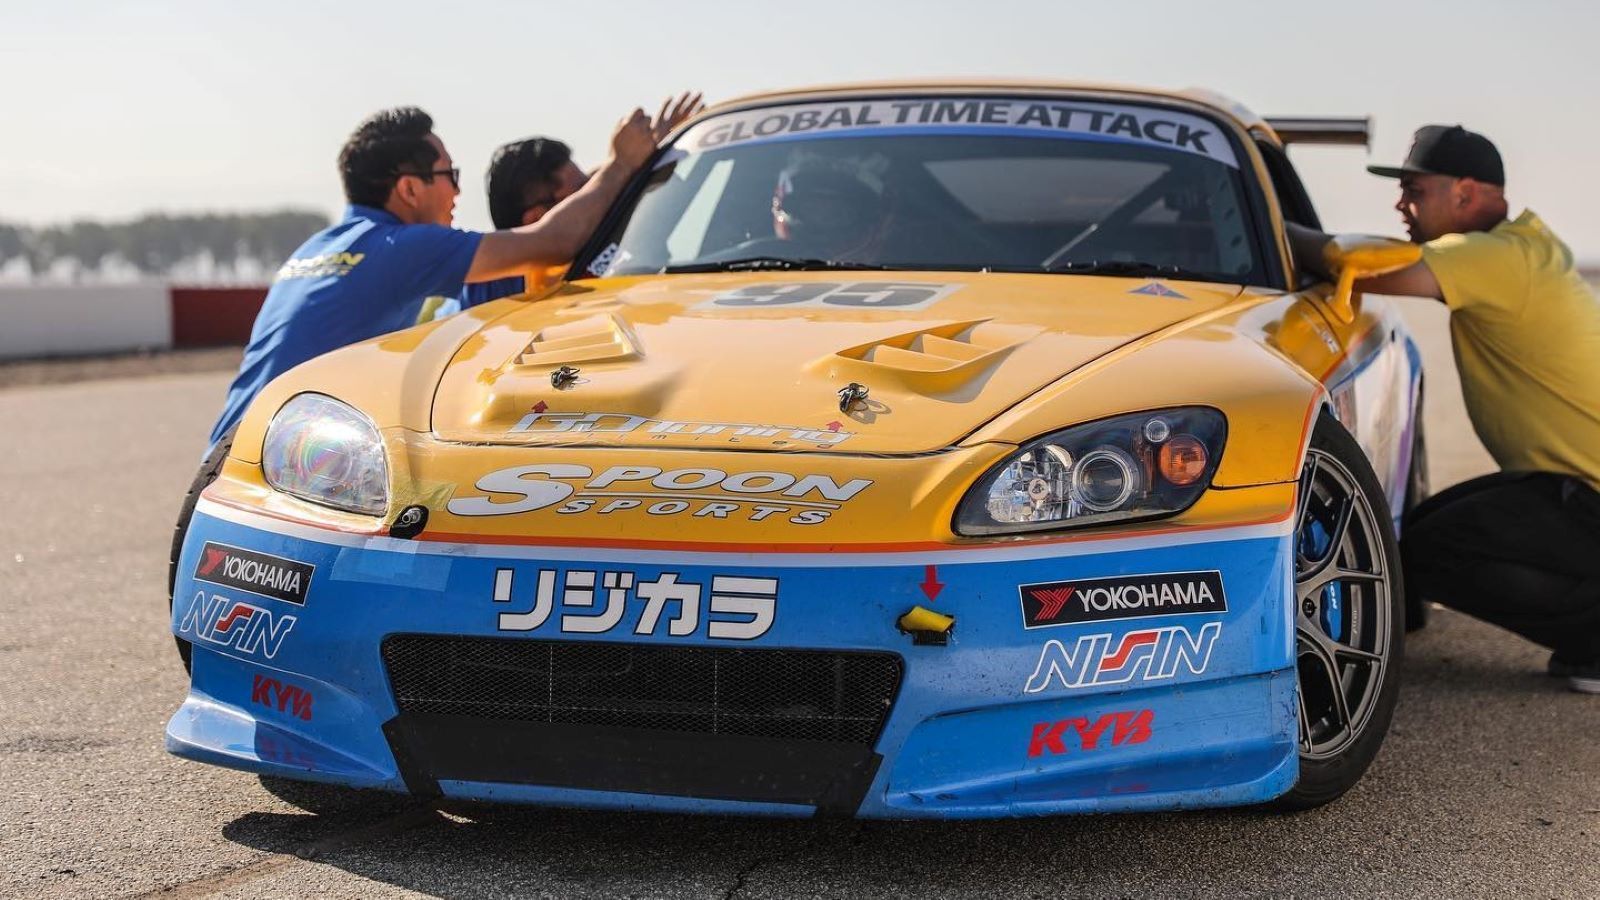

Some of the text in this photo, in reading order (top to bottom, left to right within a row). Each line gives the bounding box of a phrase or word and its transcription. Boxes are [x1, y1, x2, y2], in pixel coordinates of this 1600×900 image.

[697, 101, 1212, 153] GLOBAL TIME ATTACK
[713, 282, 945, 307] 95
[446, 463, 873, 517] SPOON
[556, 499, 831, 525] SPORTS
[221, 554, 301, 594] YOKOHAMA
[1075, 580, 1216, 612] YOKOHAMA
[493, 567, 780, 641] リジカラ
[252, 674, 313, 721] KYB
[1027, 709, 1155, 758] KYB
